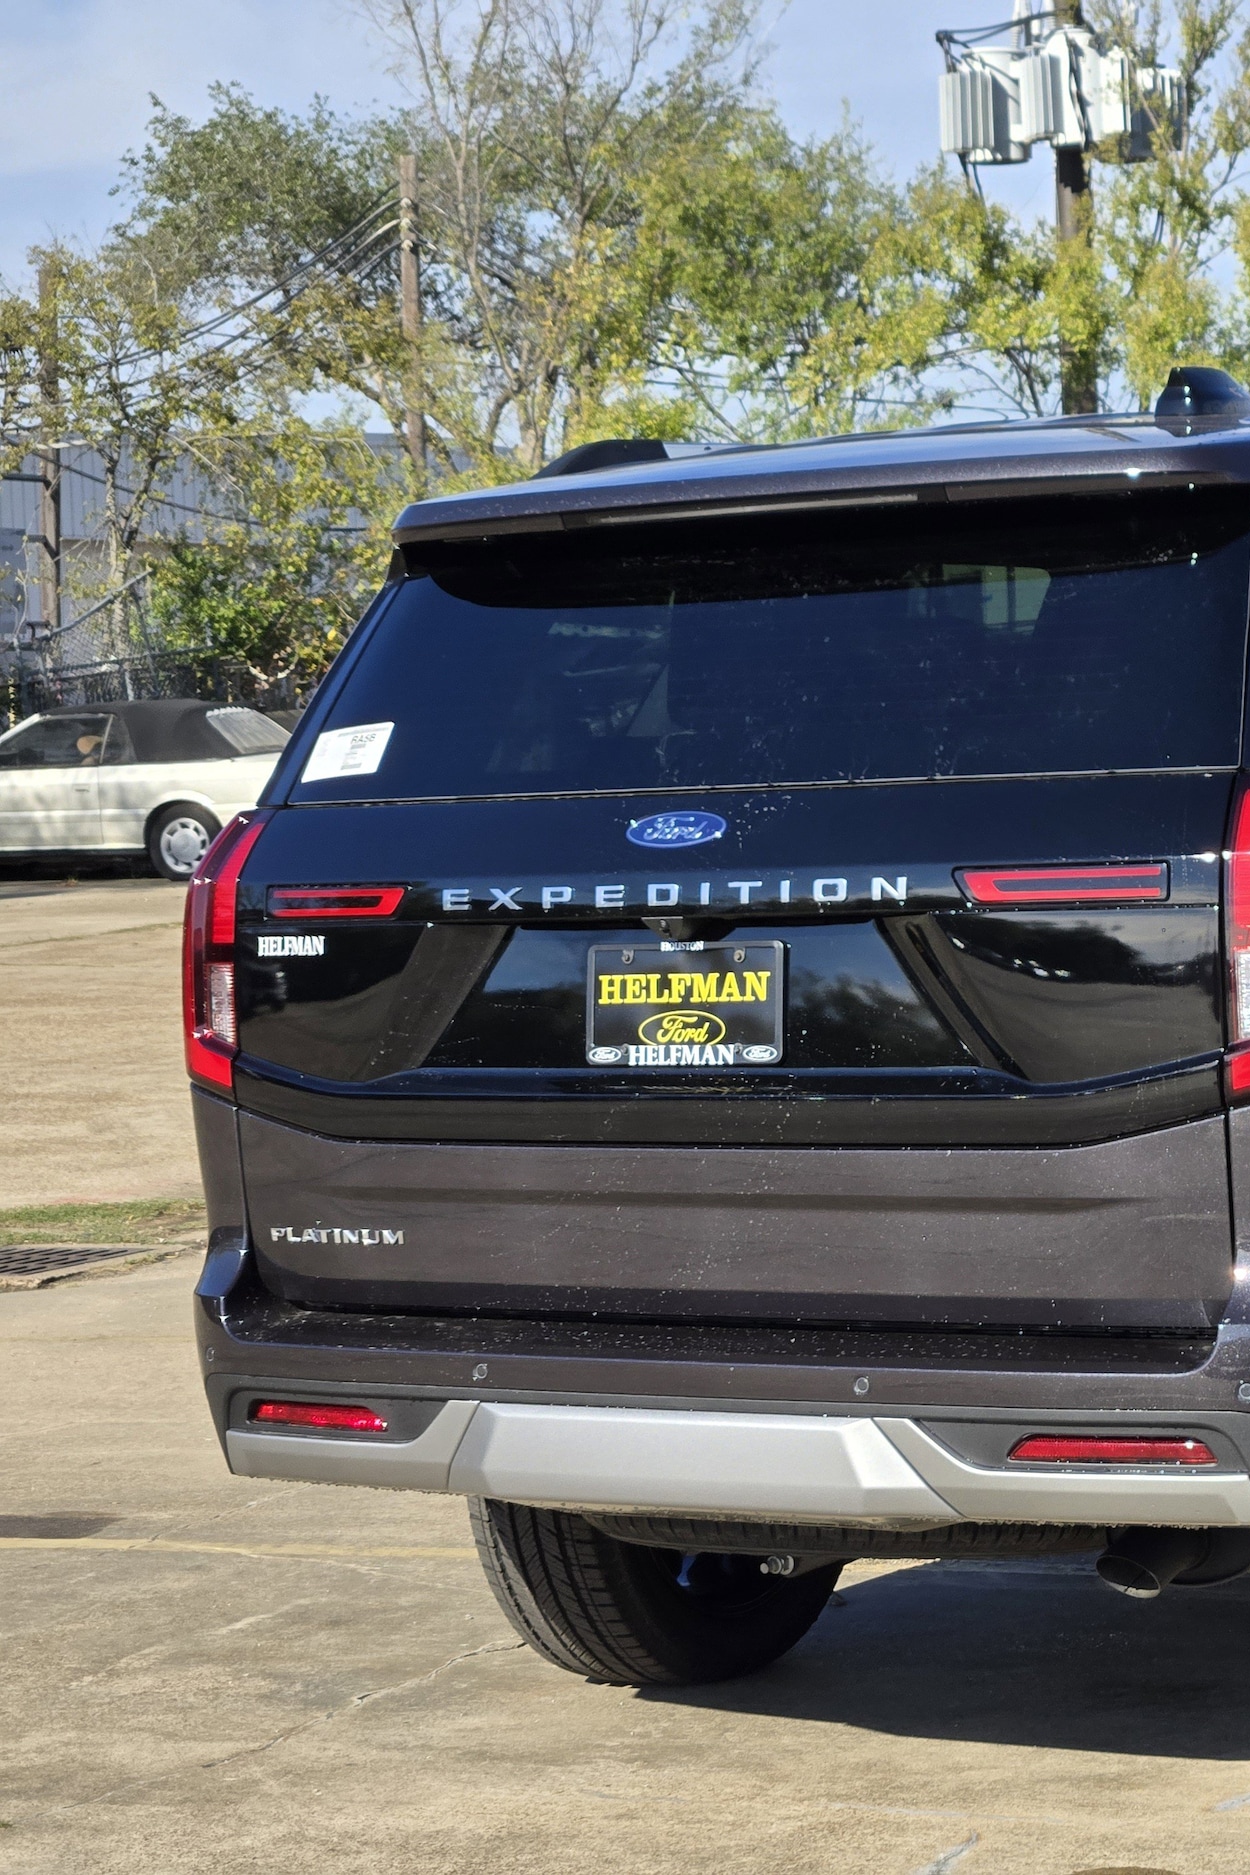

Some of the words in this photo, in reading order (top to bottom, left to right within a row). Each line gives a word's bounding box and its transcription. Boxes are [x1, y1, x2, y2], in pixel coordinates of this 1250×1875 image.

[442, 876, 908, 911] EXPEDITION
[257, 935, 326, 957] HELFMAN
[660, 941, 704, 952] HOUSTON
[598, 971, 771, 1005] HELFMAN
[656, 1015, 710, 1043] Ford
[628, 1044, 735, 1066] HELFMAN
[270, 1227, 404, 1246] PLATINUM
